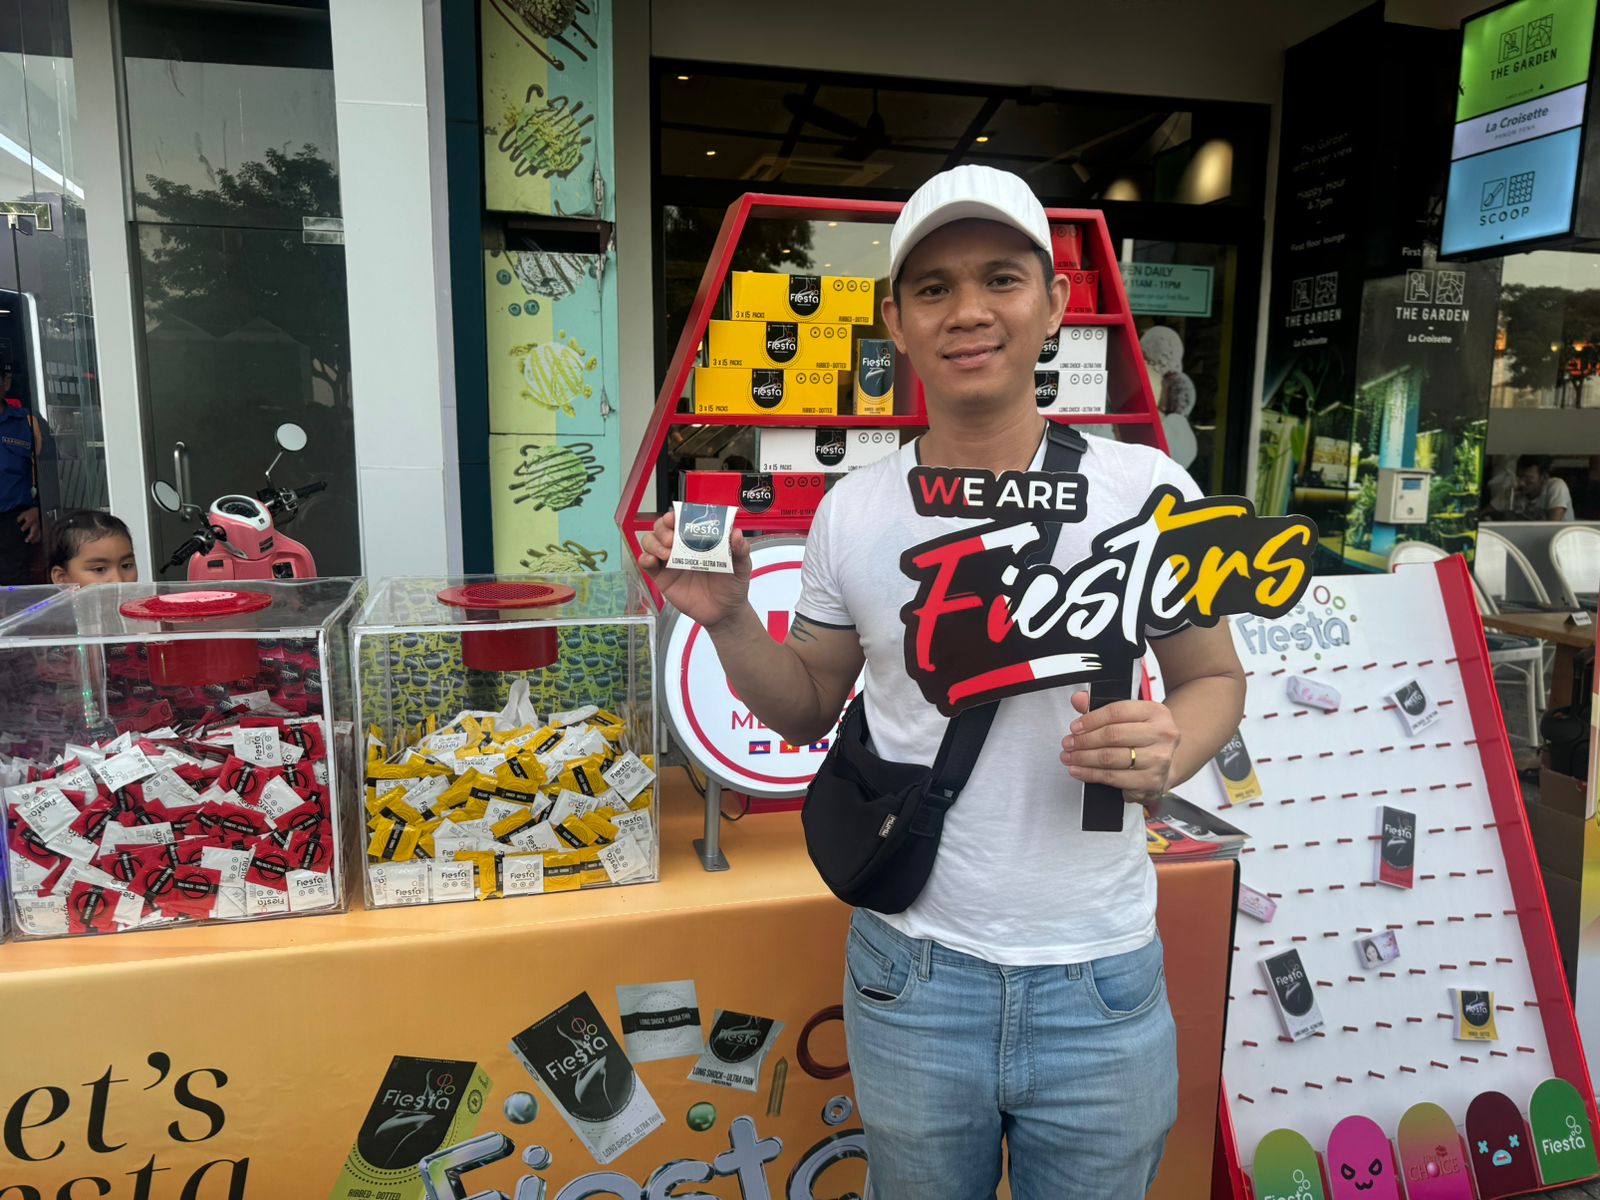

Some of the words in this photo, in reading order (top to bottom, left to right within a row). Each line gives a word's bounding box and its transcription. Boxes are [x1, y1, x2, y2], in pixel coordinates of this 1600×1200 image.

[1490, 67, 1510, 80] THE
[1513, 48, 1558, 73] GARDEN
[1485, 122, 1497, 133] La
[1500, 107, 1549, 128] Croisette
[1325, 178, 1346, 191] Hour
[1479, 206, 1530, 226] SCOOP
[1401, 246, 1421, 257] First
[1144, 265, 1174, 277] DAILY
[1160, 280, 1181, 289] 11PM
[789, 292, 819, 304] Fiesta
[735, 311, 740, 319] 3
[1285, 315, 1302, 328] THE
[1304, 308, 1342, 325] GARDEN
[1395, 306, 1418, 320] THE
[1421, 307, 1469, 322] GARDEN
[1293, 339, 1301, 348] La
[1302, 336, 1328, 347] Croisette
[1408, 334, 1417, 343] La
[1418, 334, 1452, 344] Croisette
[767, 340, 796, 351] Fiesta
[712, 358, 717, 366] 3
[862, 357, 891, 367] Fiesta
[753, 386, 782, 397] Fiesta
[816, 445, 845, 455] Fiesta
[742, 490, 771, 500] Fiesta
[918, 475, 985, 507] WE
[996, 479, 1078, 511] ARE
[685, 523, 720, 536] Fiesta
[672, 557, 685, 565] LONG
[685, 558, 698, 566] SHOCK
[1236, 611, 1350, 655] Fiesta
[98, 765, 114, 785] Fiesta
[609, 759, 631, 779] Fiesta
[30, 798, 57, 817] Fiesta
[618, 815, 642, 826] Fiesta
[1384, 824, 1412, 840] Fiesta
[526, 834, 541, 852] Fiest
[441, 869, 467, 880] Fiesta
[510, 869, 535, 880] Fiesta
[296, 875, 324, 887] Fiesta
[395, 886, 421, 896] Fiesta
[257, 898, 285, 907] Fiesta
[1275, 969, 1303, 986] Fiesta
[640, 1017, 651, 1026] LONG
[650, 1015, 665, 1025] SHOCK
[668, 1014, 682, 1024] ULTRA
[545, 1036, 609, 1081] Fiesta
[692, 1067, 707, 1077] LONG
[707, 1069, 724, 1080] SHOCK
[726, 1073, 742, 1084] ULTRA
[742, 1075, 755, 1087] THIN
[382, 1089, 450, 1111] Fiesta
[602, 1141, 618, 1158] LONG
[616, 1131, 633, 1148] SHOCK
[634, 1119, 651, 1136] ULTRA
[648, 1112, 662, 1126] THIN
[1542, 1135, 1586, 1156] Fiesta
[347, 1188, 372, 1198] RIBBED
[376, 1190, 401, 1200] DOTTED
